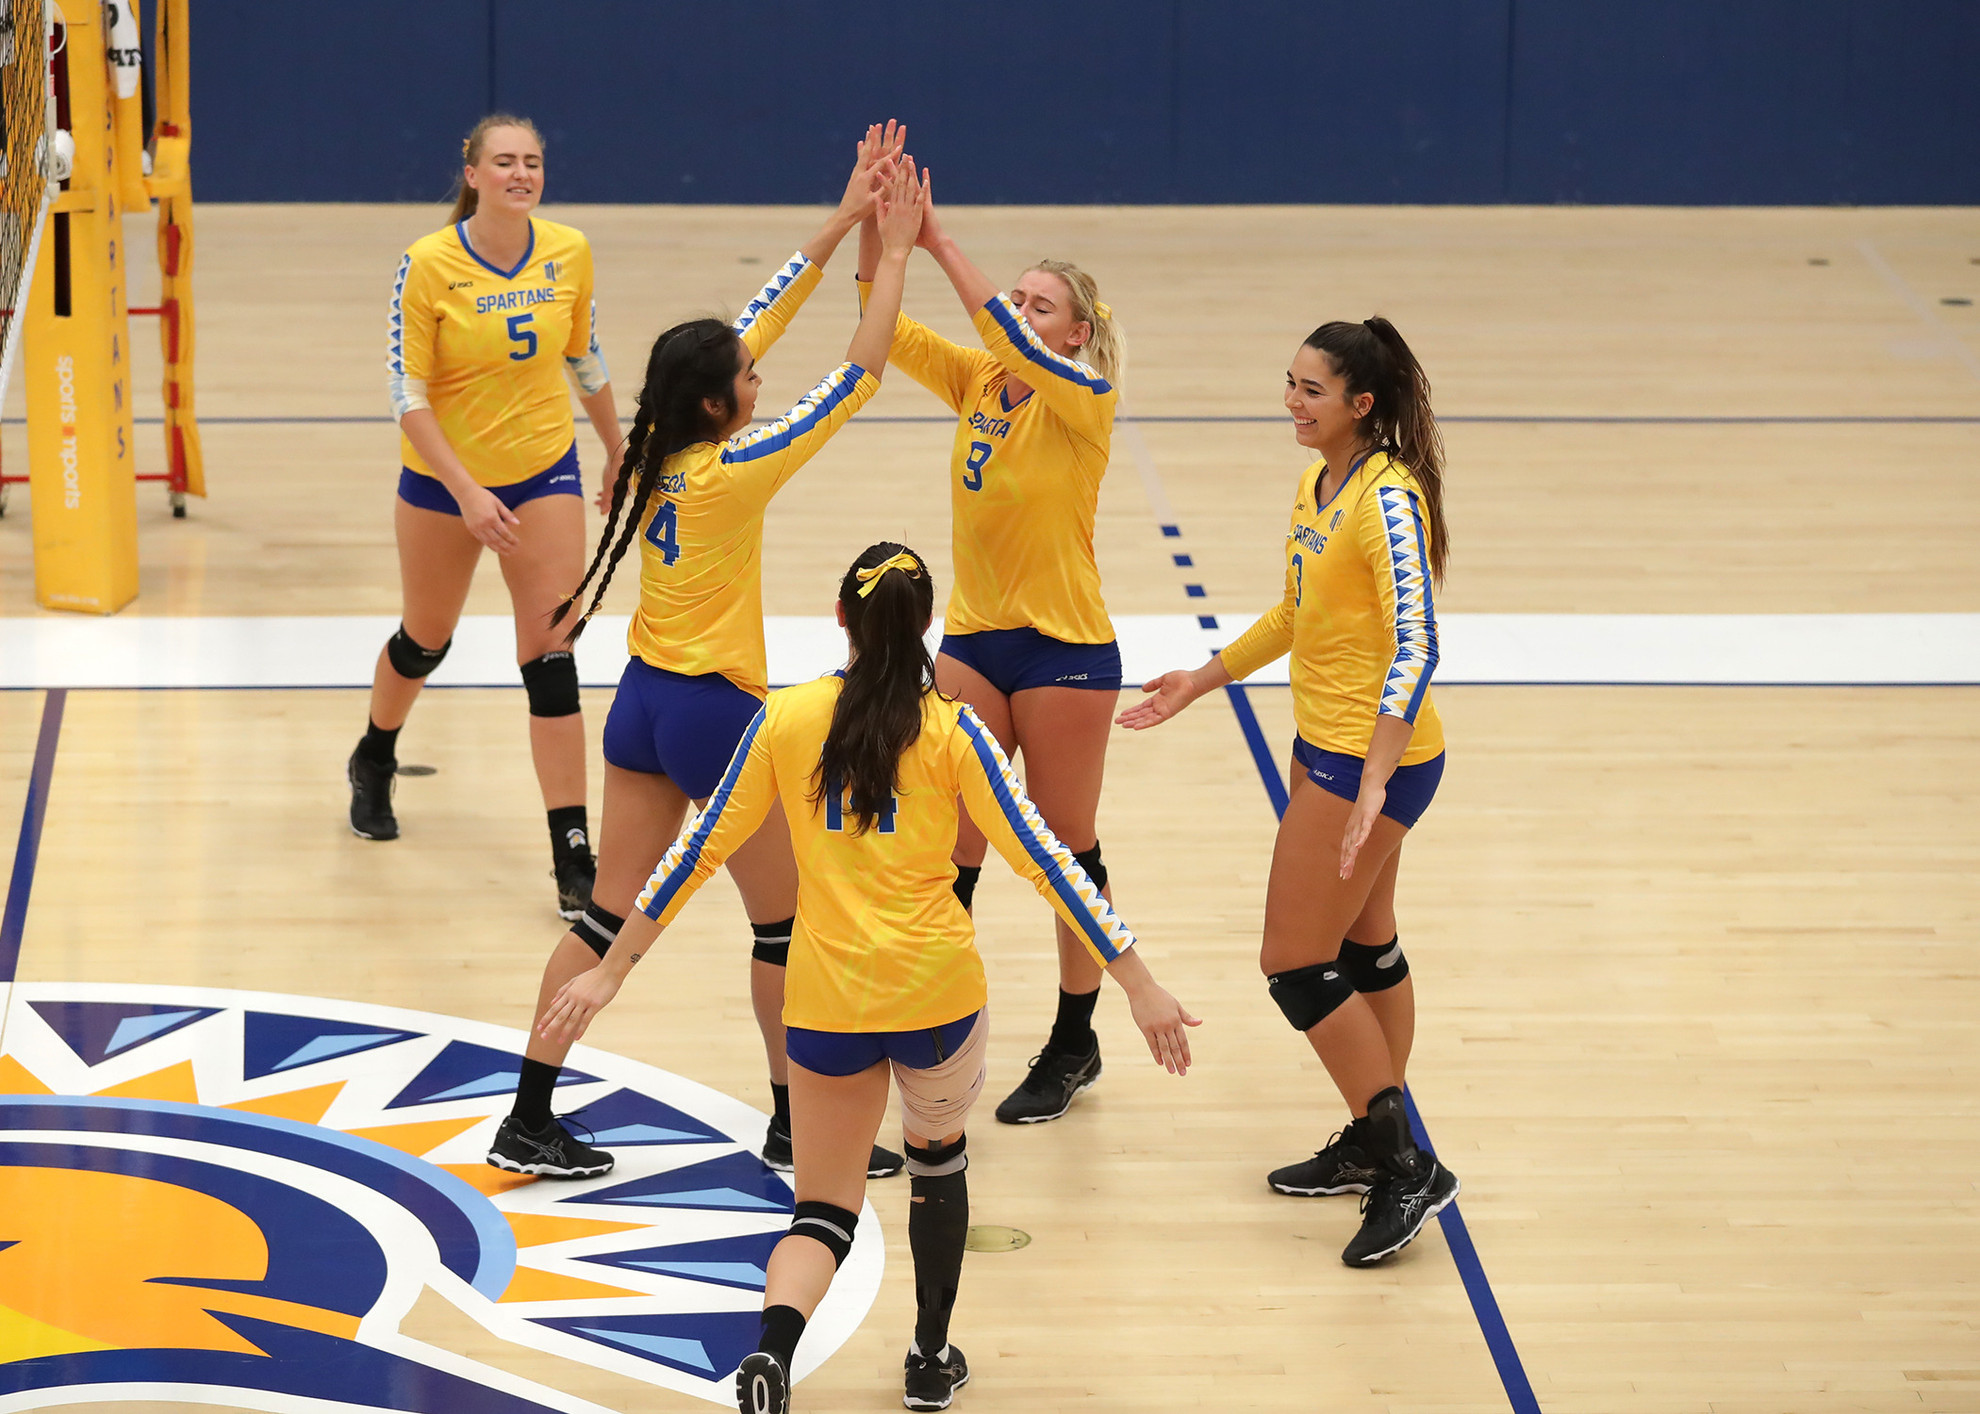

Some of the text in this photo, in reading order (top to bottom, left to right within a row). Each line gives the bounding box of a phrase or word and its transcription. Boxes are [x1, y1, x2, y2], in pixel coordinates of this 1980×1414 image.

[476, 287, 556, 314] SPARTANS
[507, 313, 538, 361] 5
[56, 354, 77, 424] sports
[963, 441, 993, 492] 9
[645, 500, 681, 567] 4
